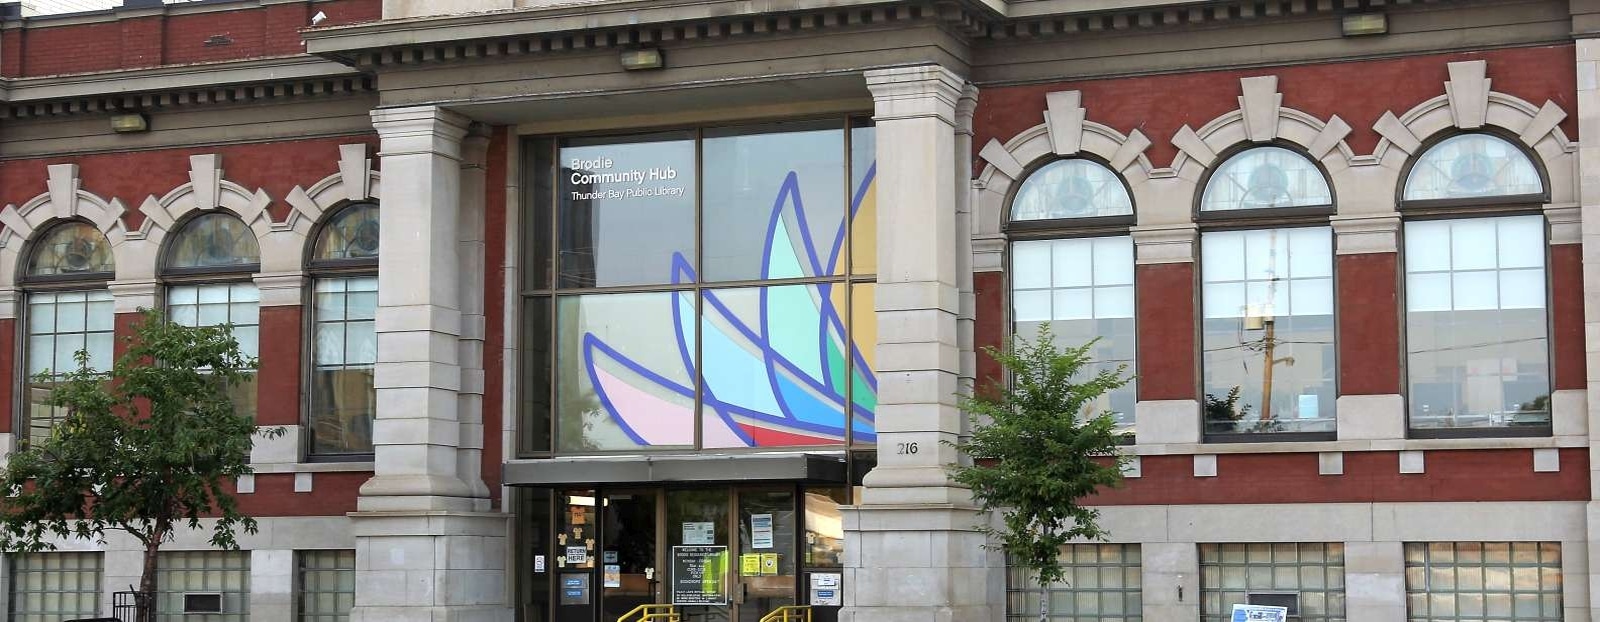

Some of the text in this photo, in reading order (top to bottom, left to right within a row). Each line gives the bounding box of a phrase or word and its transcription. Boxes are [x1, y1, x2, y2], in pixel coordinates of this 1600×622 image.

[571, 157, 613, 170] Brodie
[571, 166, 677, 184] Community Hub
[571, 184, 686, 201] Thunder Bay Public Library
[897, 442, 918, 455] 216
